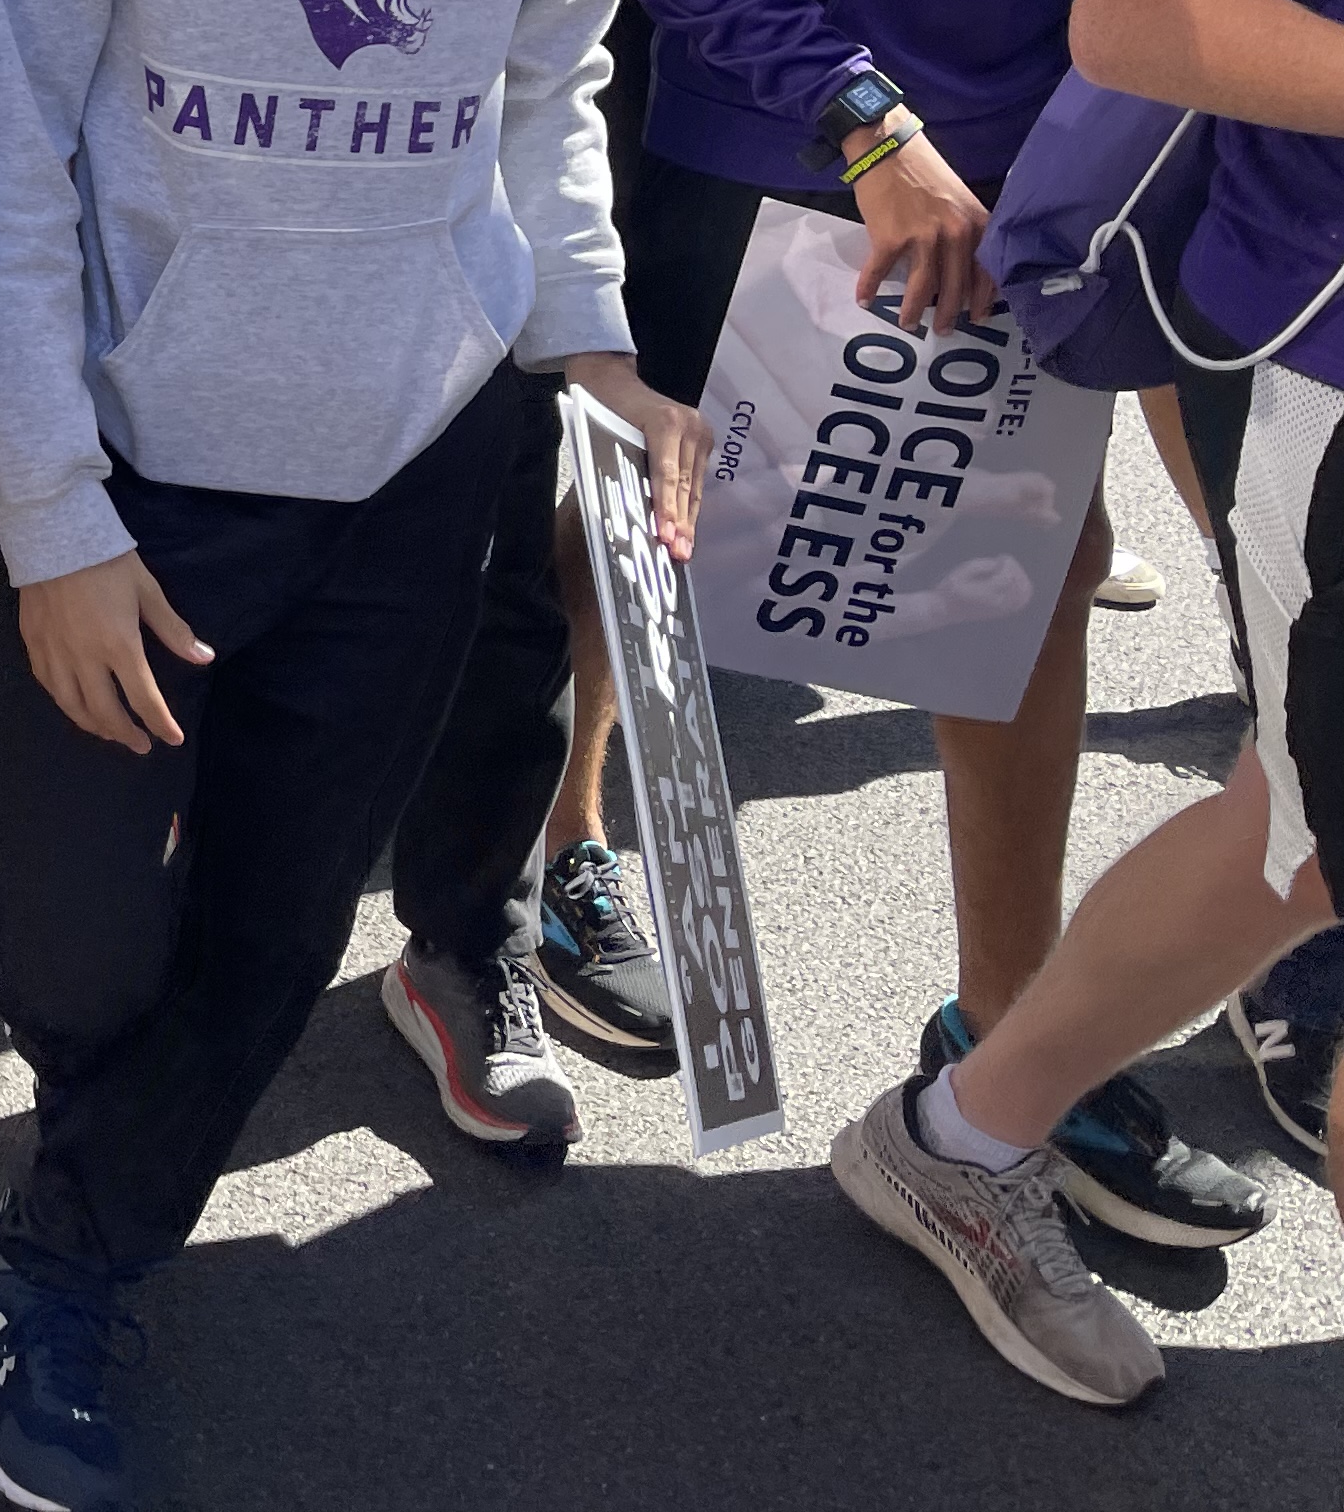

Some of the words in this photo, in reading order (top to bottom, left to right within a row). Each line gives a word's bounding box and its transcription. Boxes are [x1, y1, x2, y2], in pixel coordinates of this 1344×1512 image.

[715, 400, 757, 483] CCV.ORG
[870, 513, 925, 575] for
[835, 581, 897, 648] the
